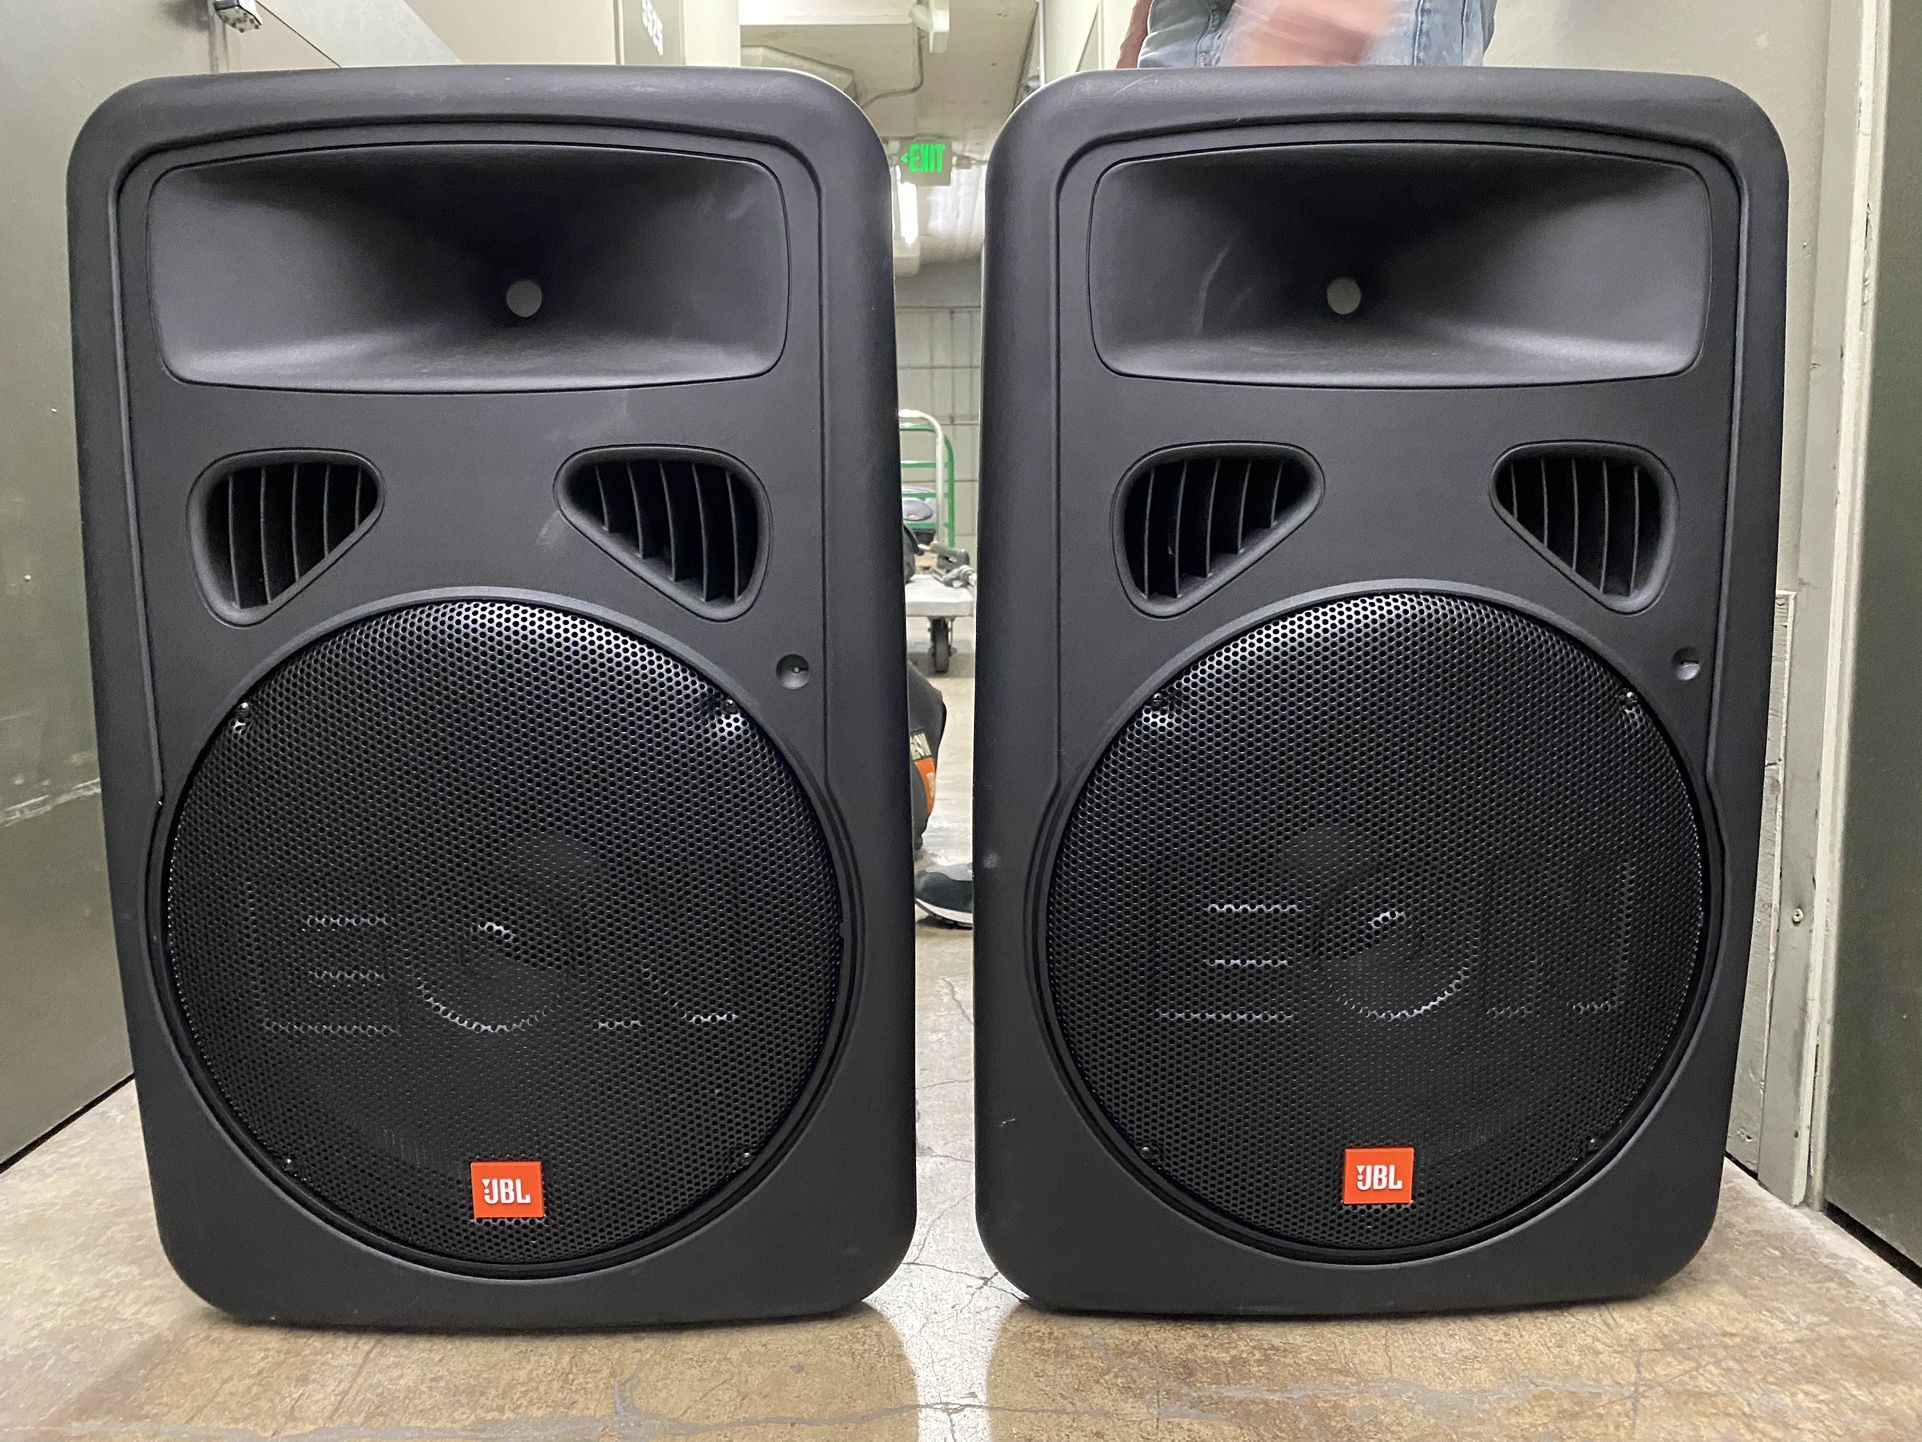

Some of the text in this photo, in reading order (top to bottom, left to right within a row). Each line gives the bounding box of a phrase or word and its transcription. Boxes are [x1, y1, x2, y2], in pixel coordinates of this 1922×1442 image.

[908, 143, 945, 173] EXIT
[1356, 1164, 1403, 1191] JBL
[481, 1178, 532, 1205] JBL
